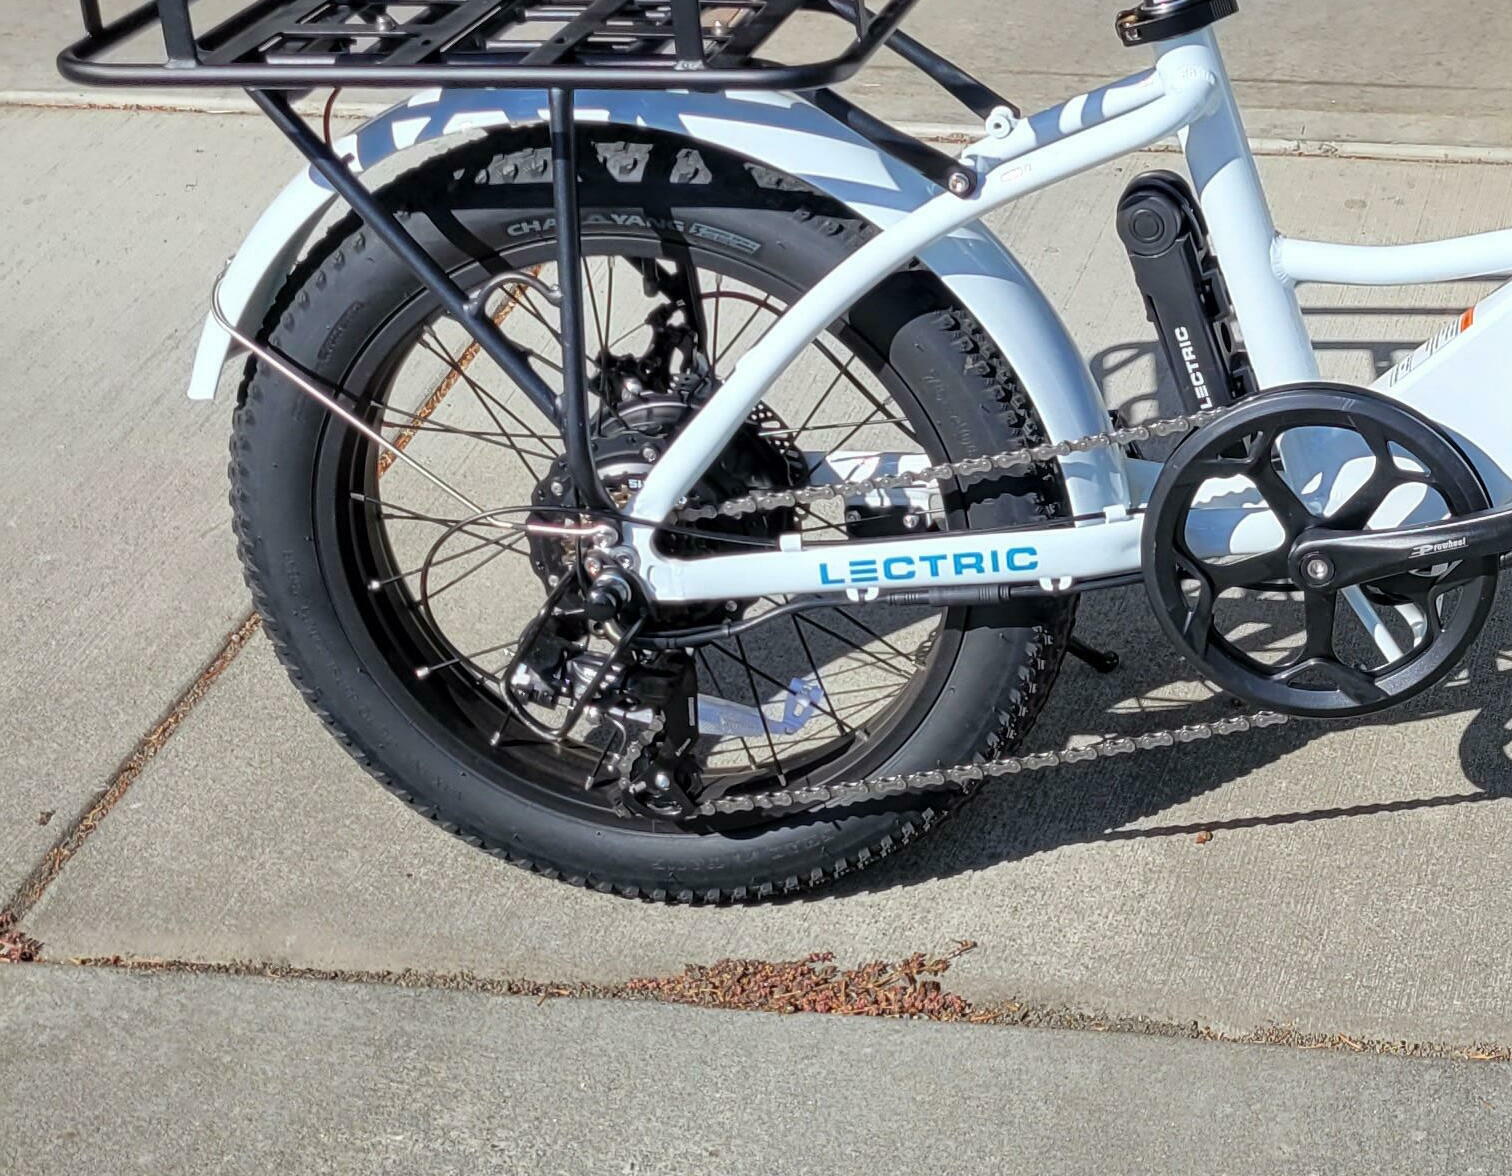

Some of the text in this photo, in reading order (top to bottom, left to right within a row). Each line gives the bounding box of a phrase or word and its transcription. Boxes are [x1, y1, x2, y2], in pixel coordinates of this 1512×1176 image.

[1174, 326, 1213, 410] LECTRIC
[819, 546, 1039, 585] LECTRIC
[1409, 537, 1467, 557] Prowheel
